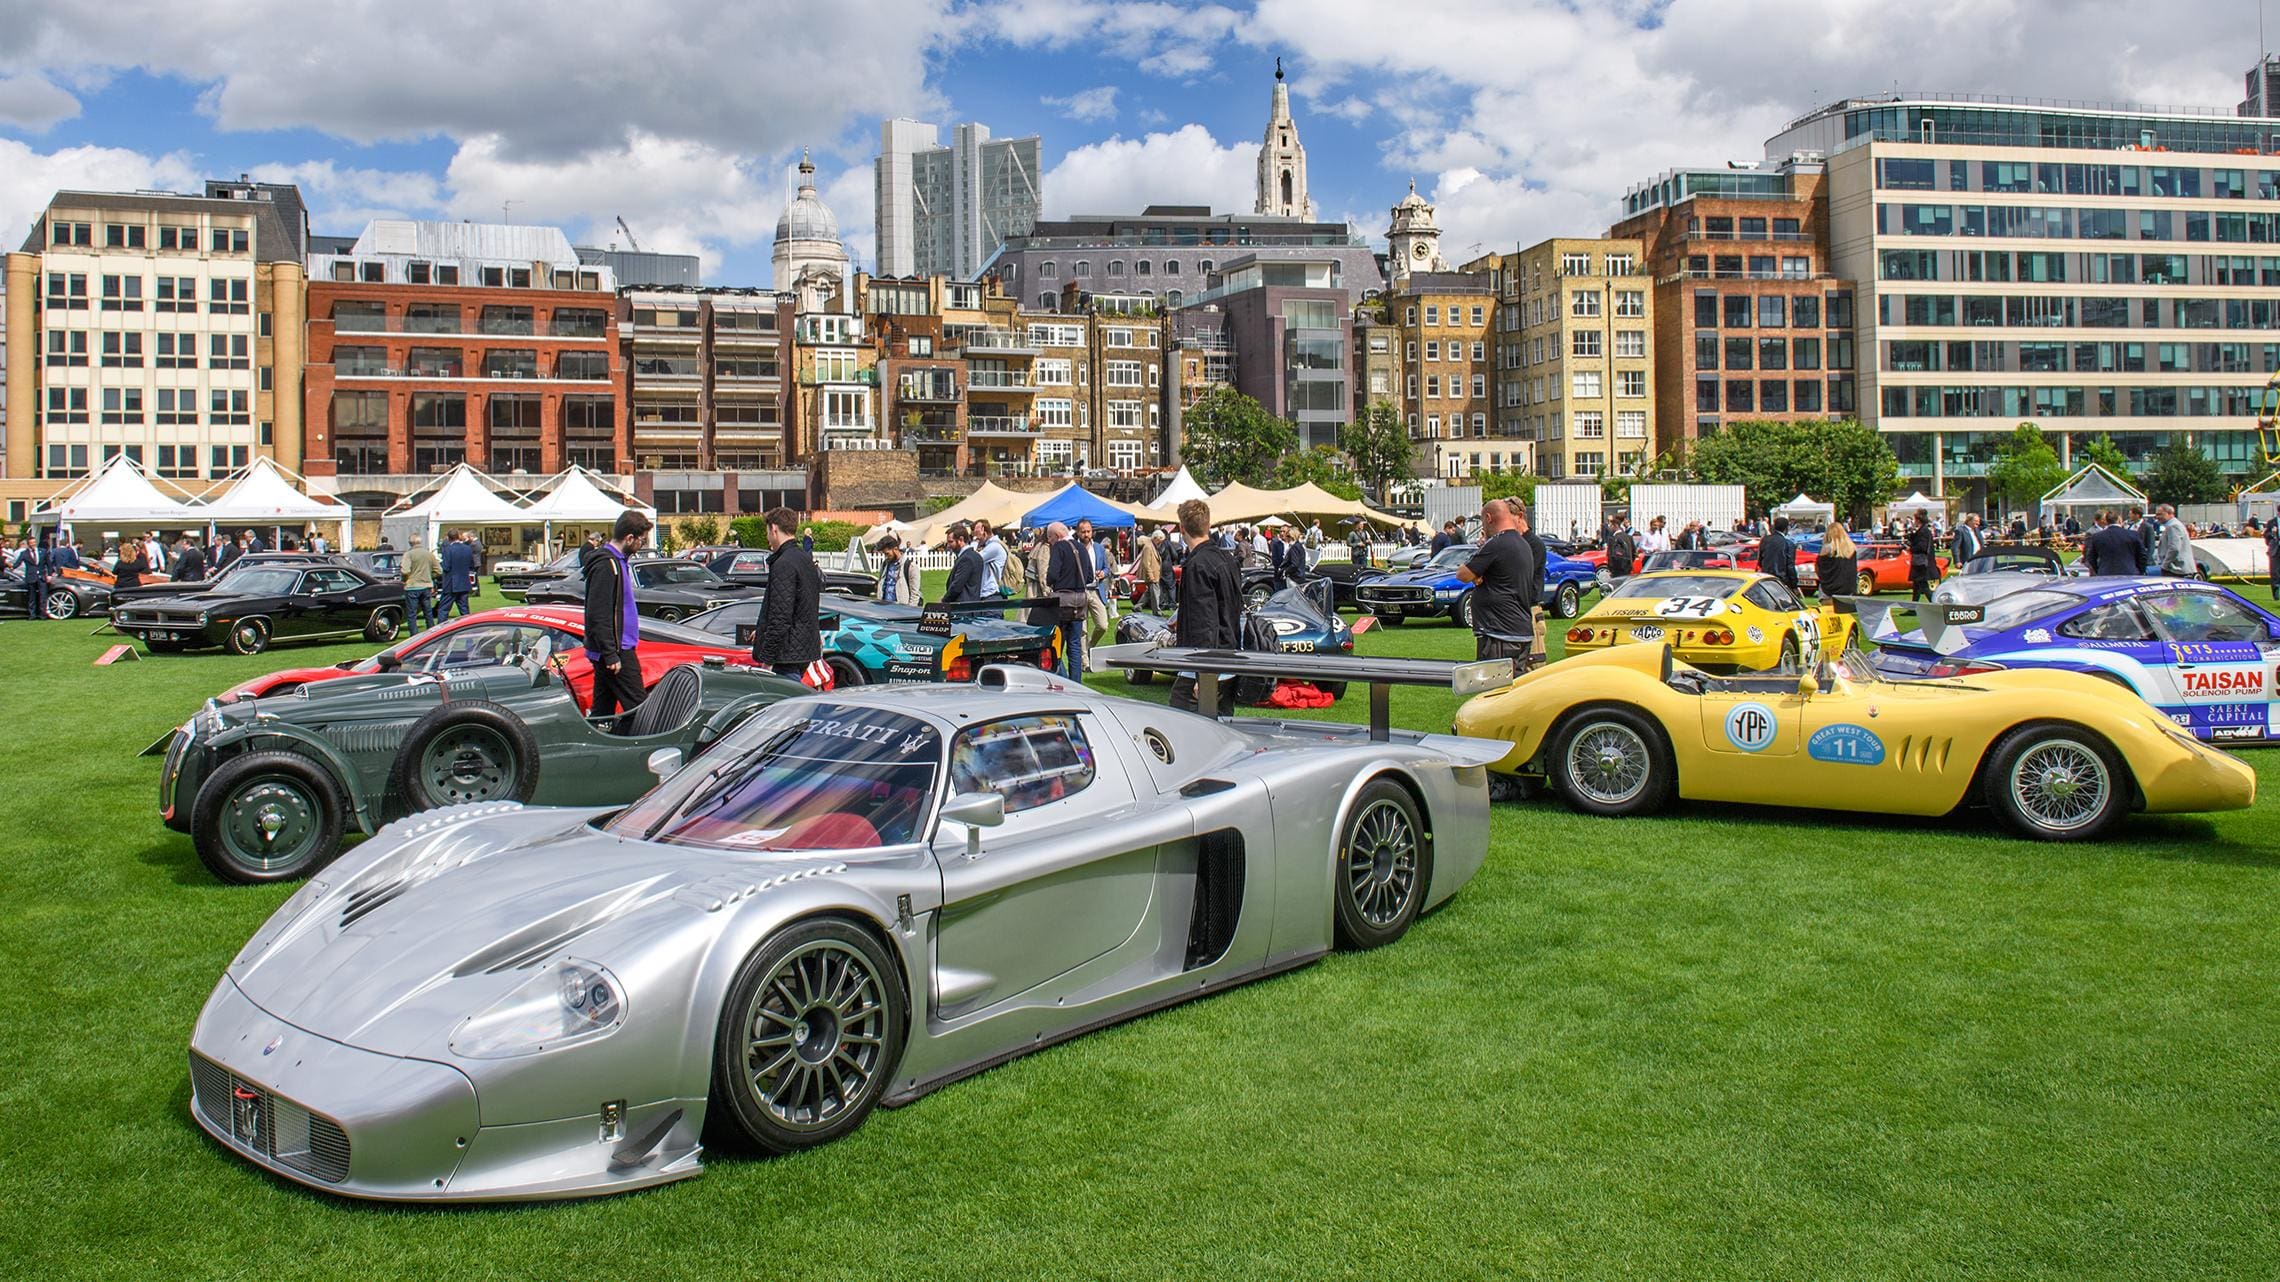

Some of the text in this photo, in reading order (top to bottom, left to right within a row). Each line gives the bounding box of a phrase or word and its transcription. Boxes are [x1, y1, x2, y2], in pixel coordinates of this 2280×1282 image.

[1661, 597, 1715, 616] 34
[924, 611, 949, 620] TWR
[920, 625, 949, 633] DUNLOP
[1632, 625, 1662, 639] YACCO
[889, 665, 931, 675] Snap-on
[2182, 671, 2263, 690] TAISAN
[2182, 689, 2231, 698] SOLENOID
[2209, 704, 2248, 713] SAEKI
[2207, 712, 2264, 722] CAPITAL
[1734, 710, 1768, 743] YPF
[1811, 726, 1881, 751] GREAT WEST TOUR
[1833, 738, 1857, 757] 11
